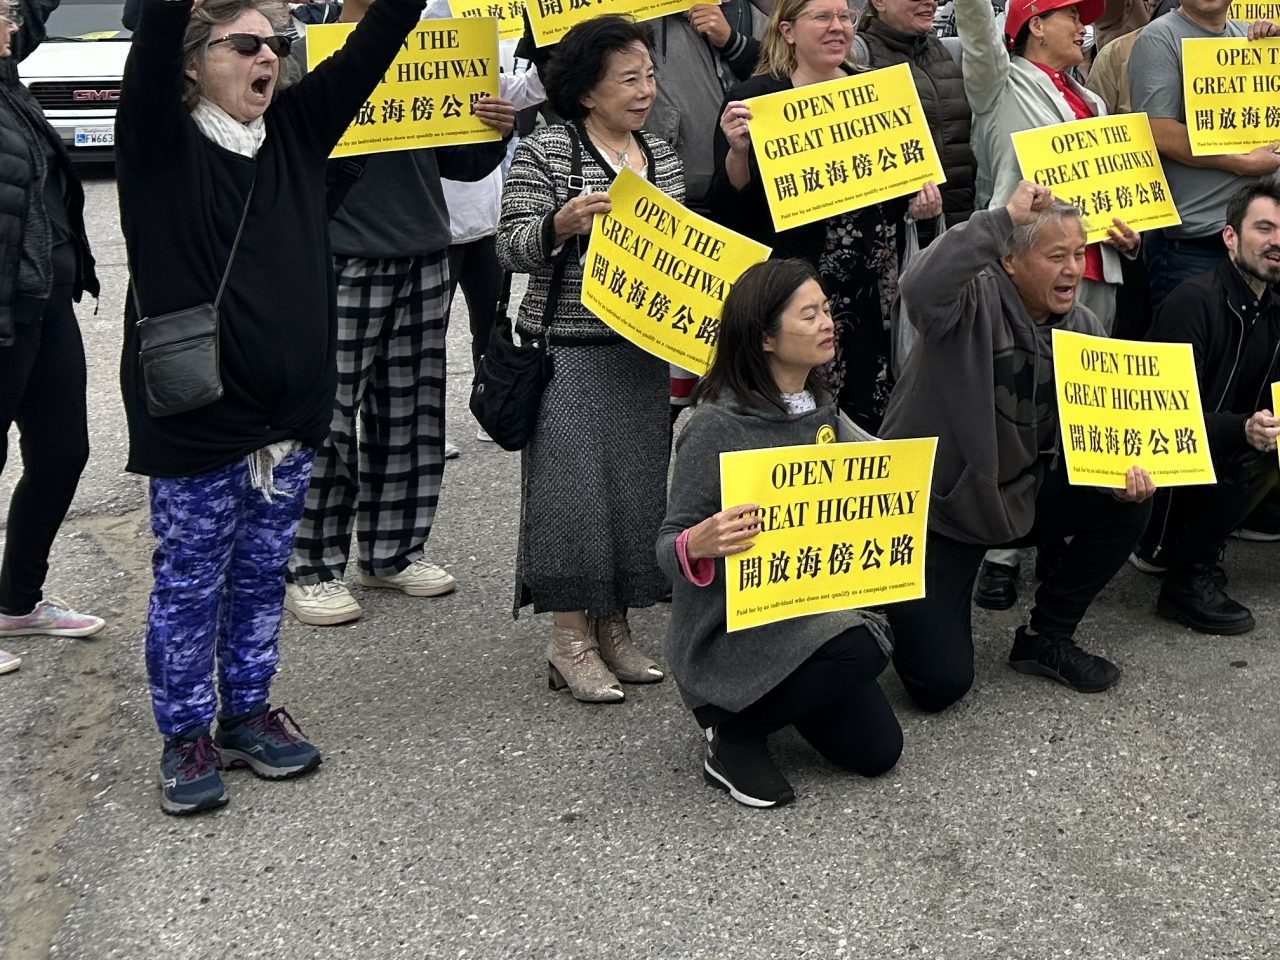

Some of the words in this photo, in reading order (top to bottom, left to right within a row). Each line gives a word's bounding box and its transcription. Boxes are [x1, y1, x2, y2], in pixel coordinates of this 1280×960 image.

[397, 58, 492, 83] HIGHWAY
[1216, 48, 1263, 66] OPEN
[73, 89, 122, 101] GMC
[1192, 76, 1247, 95] GREAT
[783, 93, 836, 123] OPEN
[837, 83, 879, 109] THE
[764, 127, 825, 161] GREAT
[831, 105, 913, 145] HIGHWAY
[1051, 130, 1098, 155] OPEN
[1100, 124, 1132, 144] THE
[1096, 149, 1155, 176] HIGHWAY
[1081, 348, 1120, 375] OPEN
[1123, 354, 1160, 377] THE
[1064, 381, 1108, 408] GREAT
[1111, 388, 1190, 411] HIGHWAY
[1069, 423, 1198, 457] 開放海傍公路
[771, 458, 836, 490] OPEN
[843, 455, 892, 482] THE
[816, 490, 920, 525] HIGHWAY
[739, 534, 915, 591] 開放海傍公路
